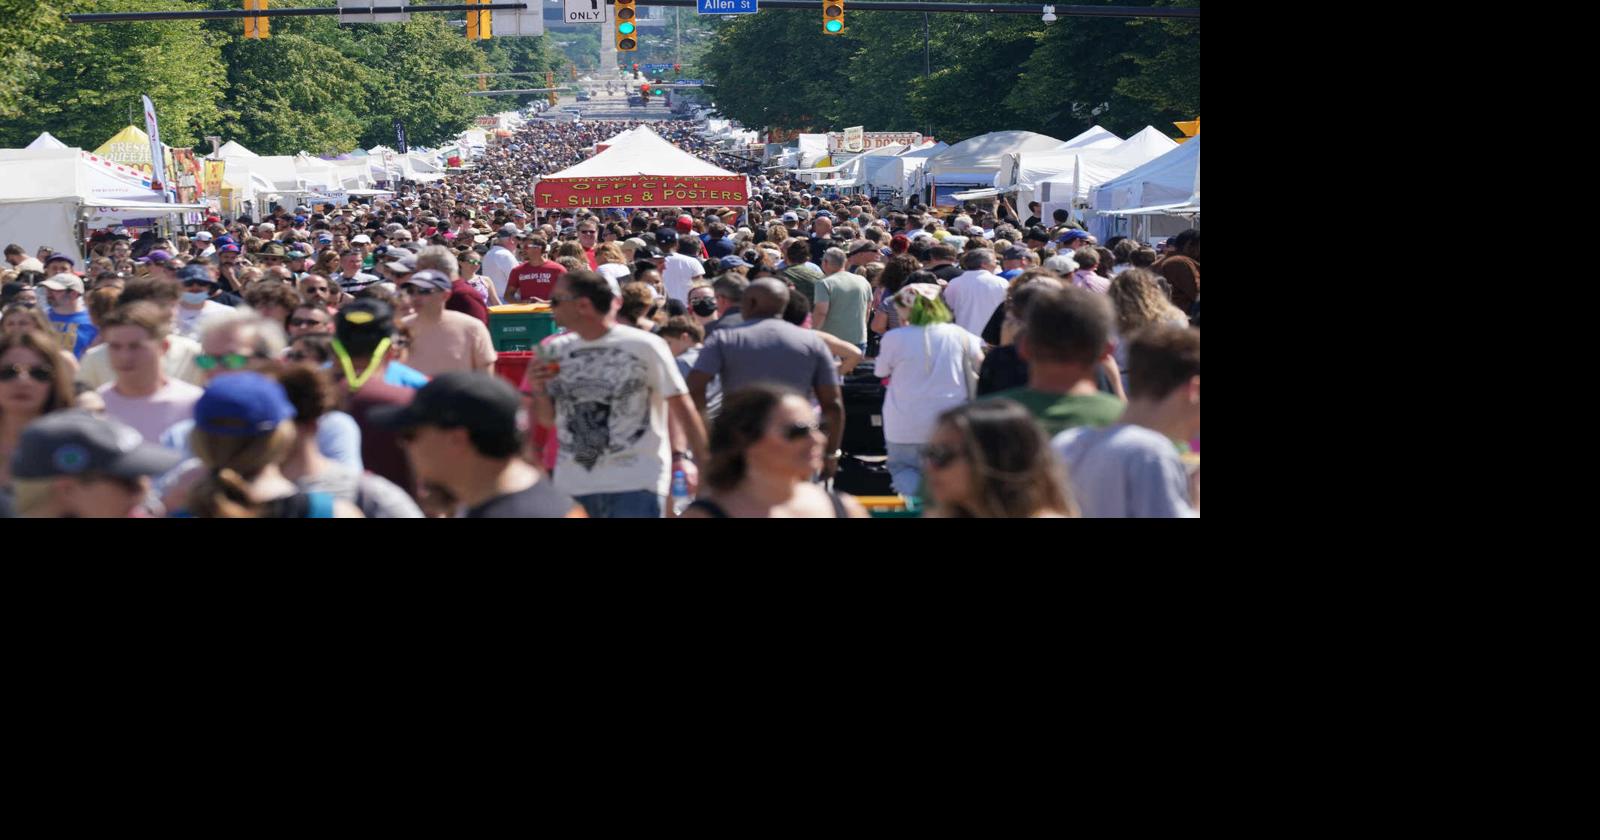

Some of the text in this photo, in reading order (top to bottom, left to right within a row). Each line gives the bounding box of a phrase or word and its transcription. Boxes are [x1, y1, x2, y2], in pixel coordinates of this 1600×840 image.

[704, 0, 751, 9] Allen St
[570, 11, 600, 20] ONLY
[875, 138, 915, 148] DOGH
[572, 182, 706, 190] OFFICIAL
[568, 193, 633, 205] SHIRTS
[642, 191, 653, 201] &
[663, 189, 742, 200] POSTERS
